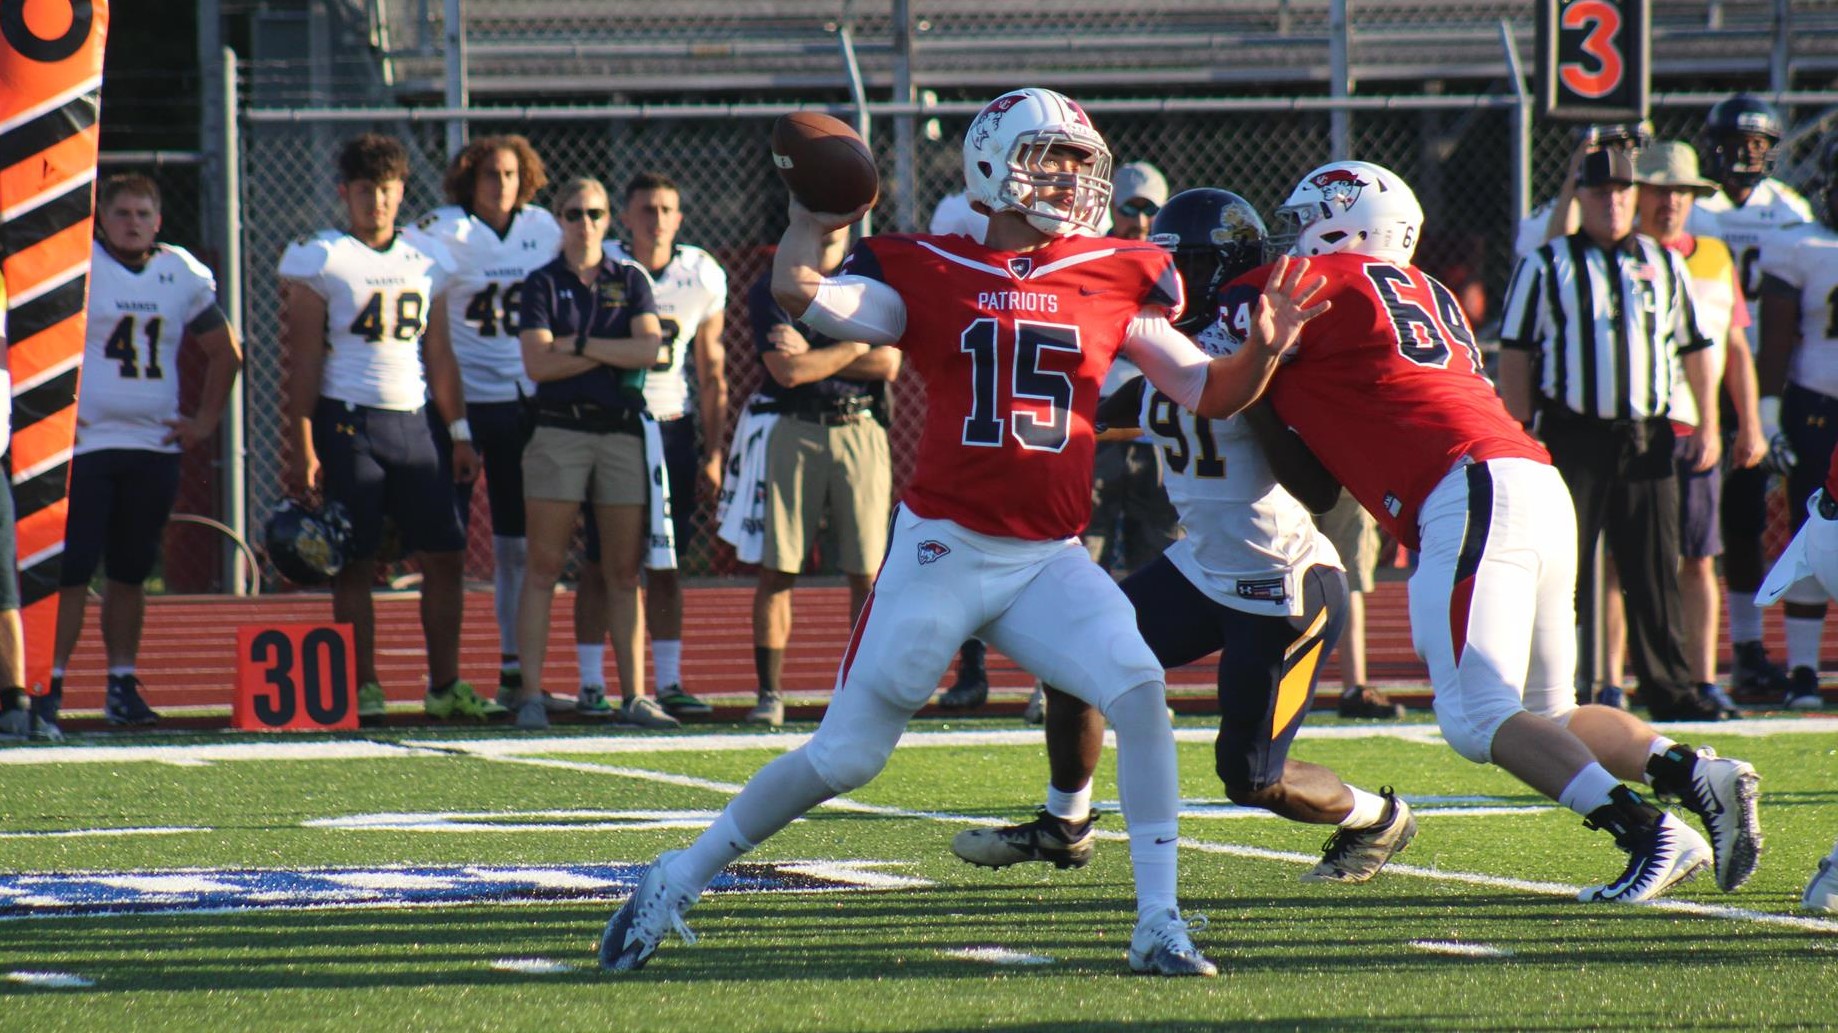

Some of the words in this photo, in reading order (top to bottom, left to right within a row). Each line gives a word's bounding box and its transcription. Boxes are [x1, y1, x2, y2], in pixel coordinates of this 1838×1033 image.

[1560, 0, 1623, 98] 3
[104, 314, 164, 380] 41
[115, 301, 158, 311] WARNER
[350, 290, 423, 342] 48
[978, 291, 1058, 313] PATRIOTS
[1363, 262, 1494, 388] 64
[960, 317, 1081, 454] 15
[1148, 388, 1227, 479] 91
[251, 628, 349, 726] 30
